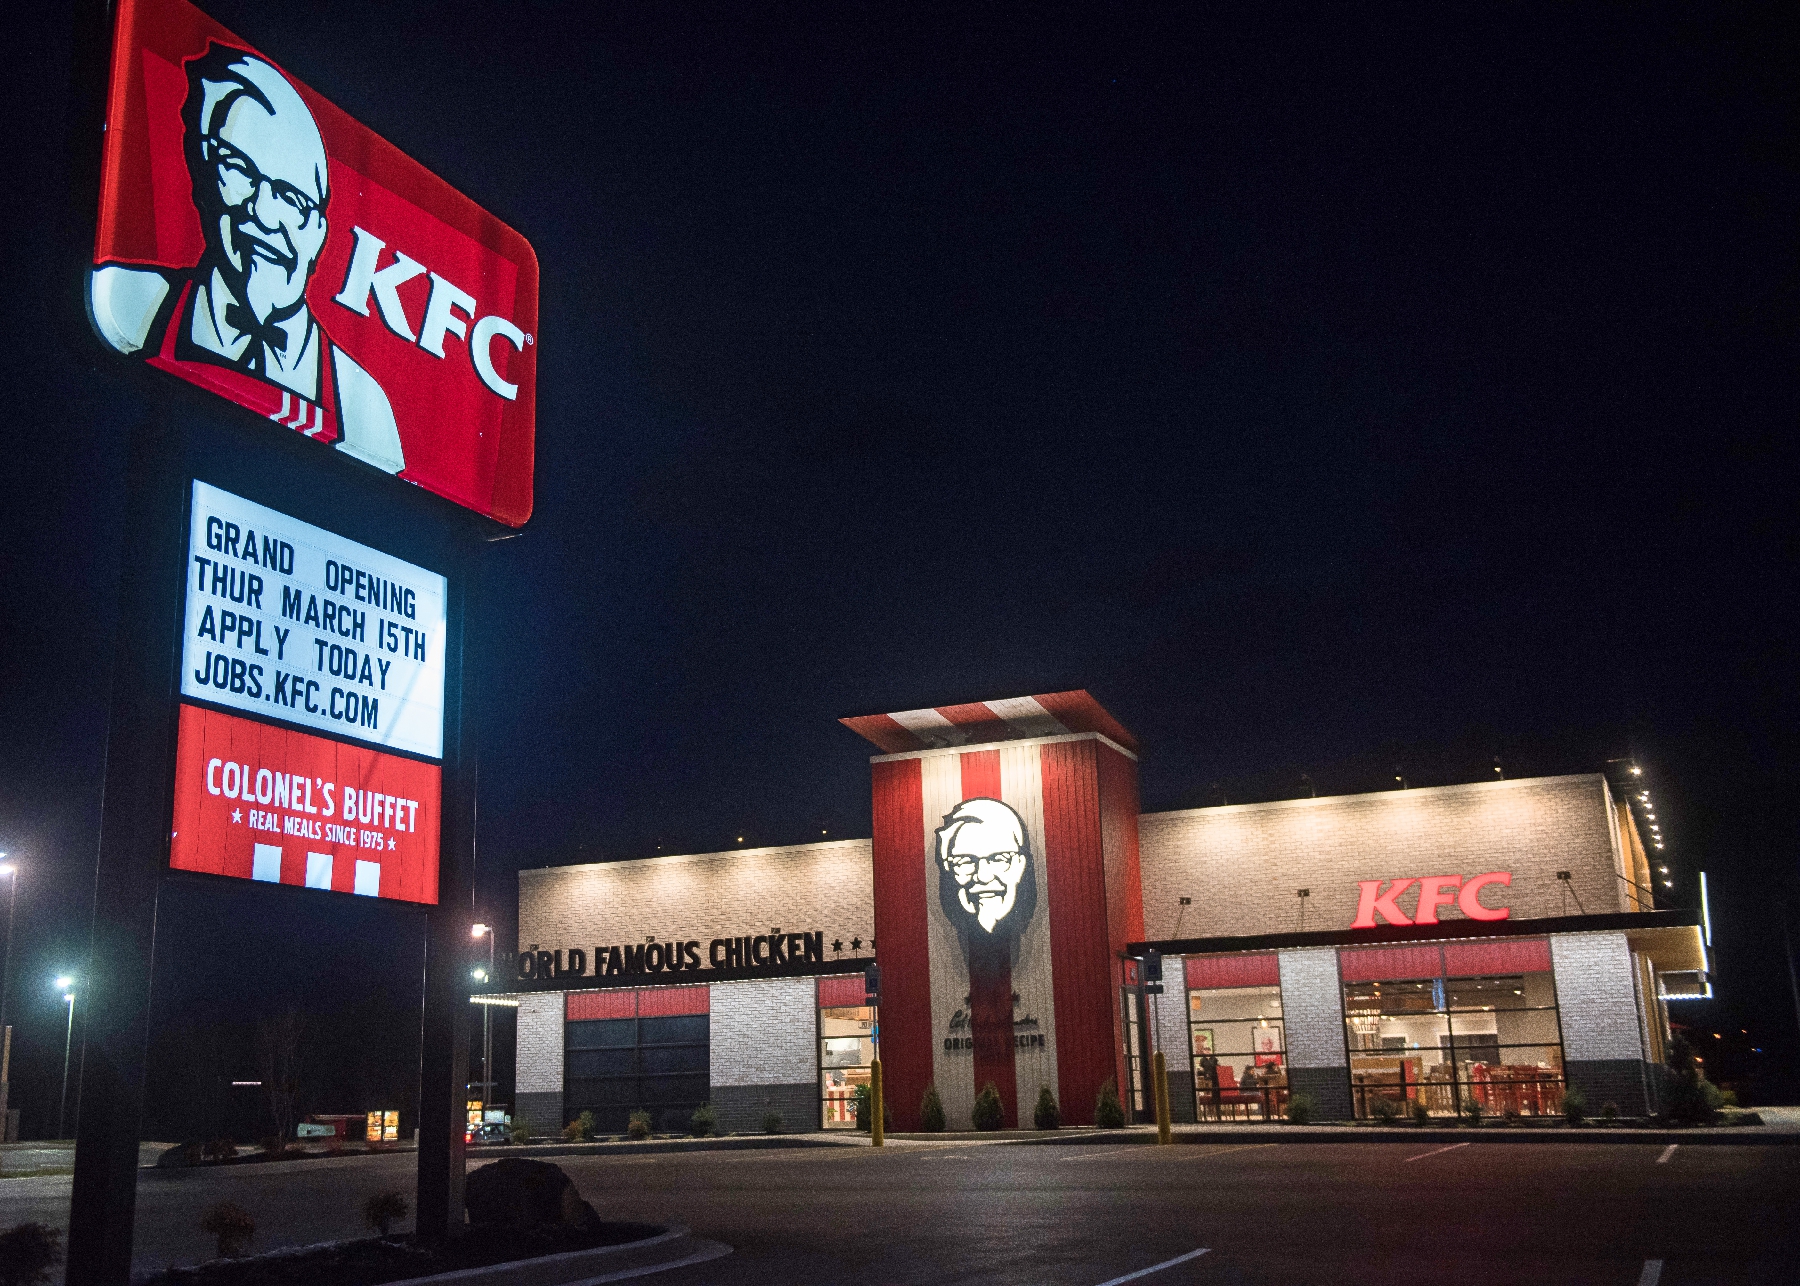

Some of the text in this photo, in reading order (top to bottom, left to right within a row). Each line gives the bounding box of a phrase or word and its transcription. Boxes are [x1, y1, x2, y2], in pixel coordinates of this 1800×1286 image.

[335, 225, 524, 400] KFC
[206, 515, 416, 620] GRAND OPENING
[194, 555, 426, 662] THUR MARCH 15TH
[197, 604, 391, 691] APPLY TODAY
[194, 651, 379, 730] JOBS.KFC.COM
[206, 757, 419, 833] COLONEL'S BUFFET
[249, 808, 384, 850] REAL MEALS SINCE 1975
[1350, 871, 1513, 929] KFC
[594, 940, 701, 977] FAMOUS
[709, 930, 824, 969] CHICKEN
